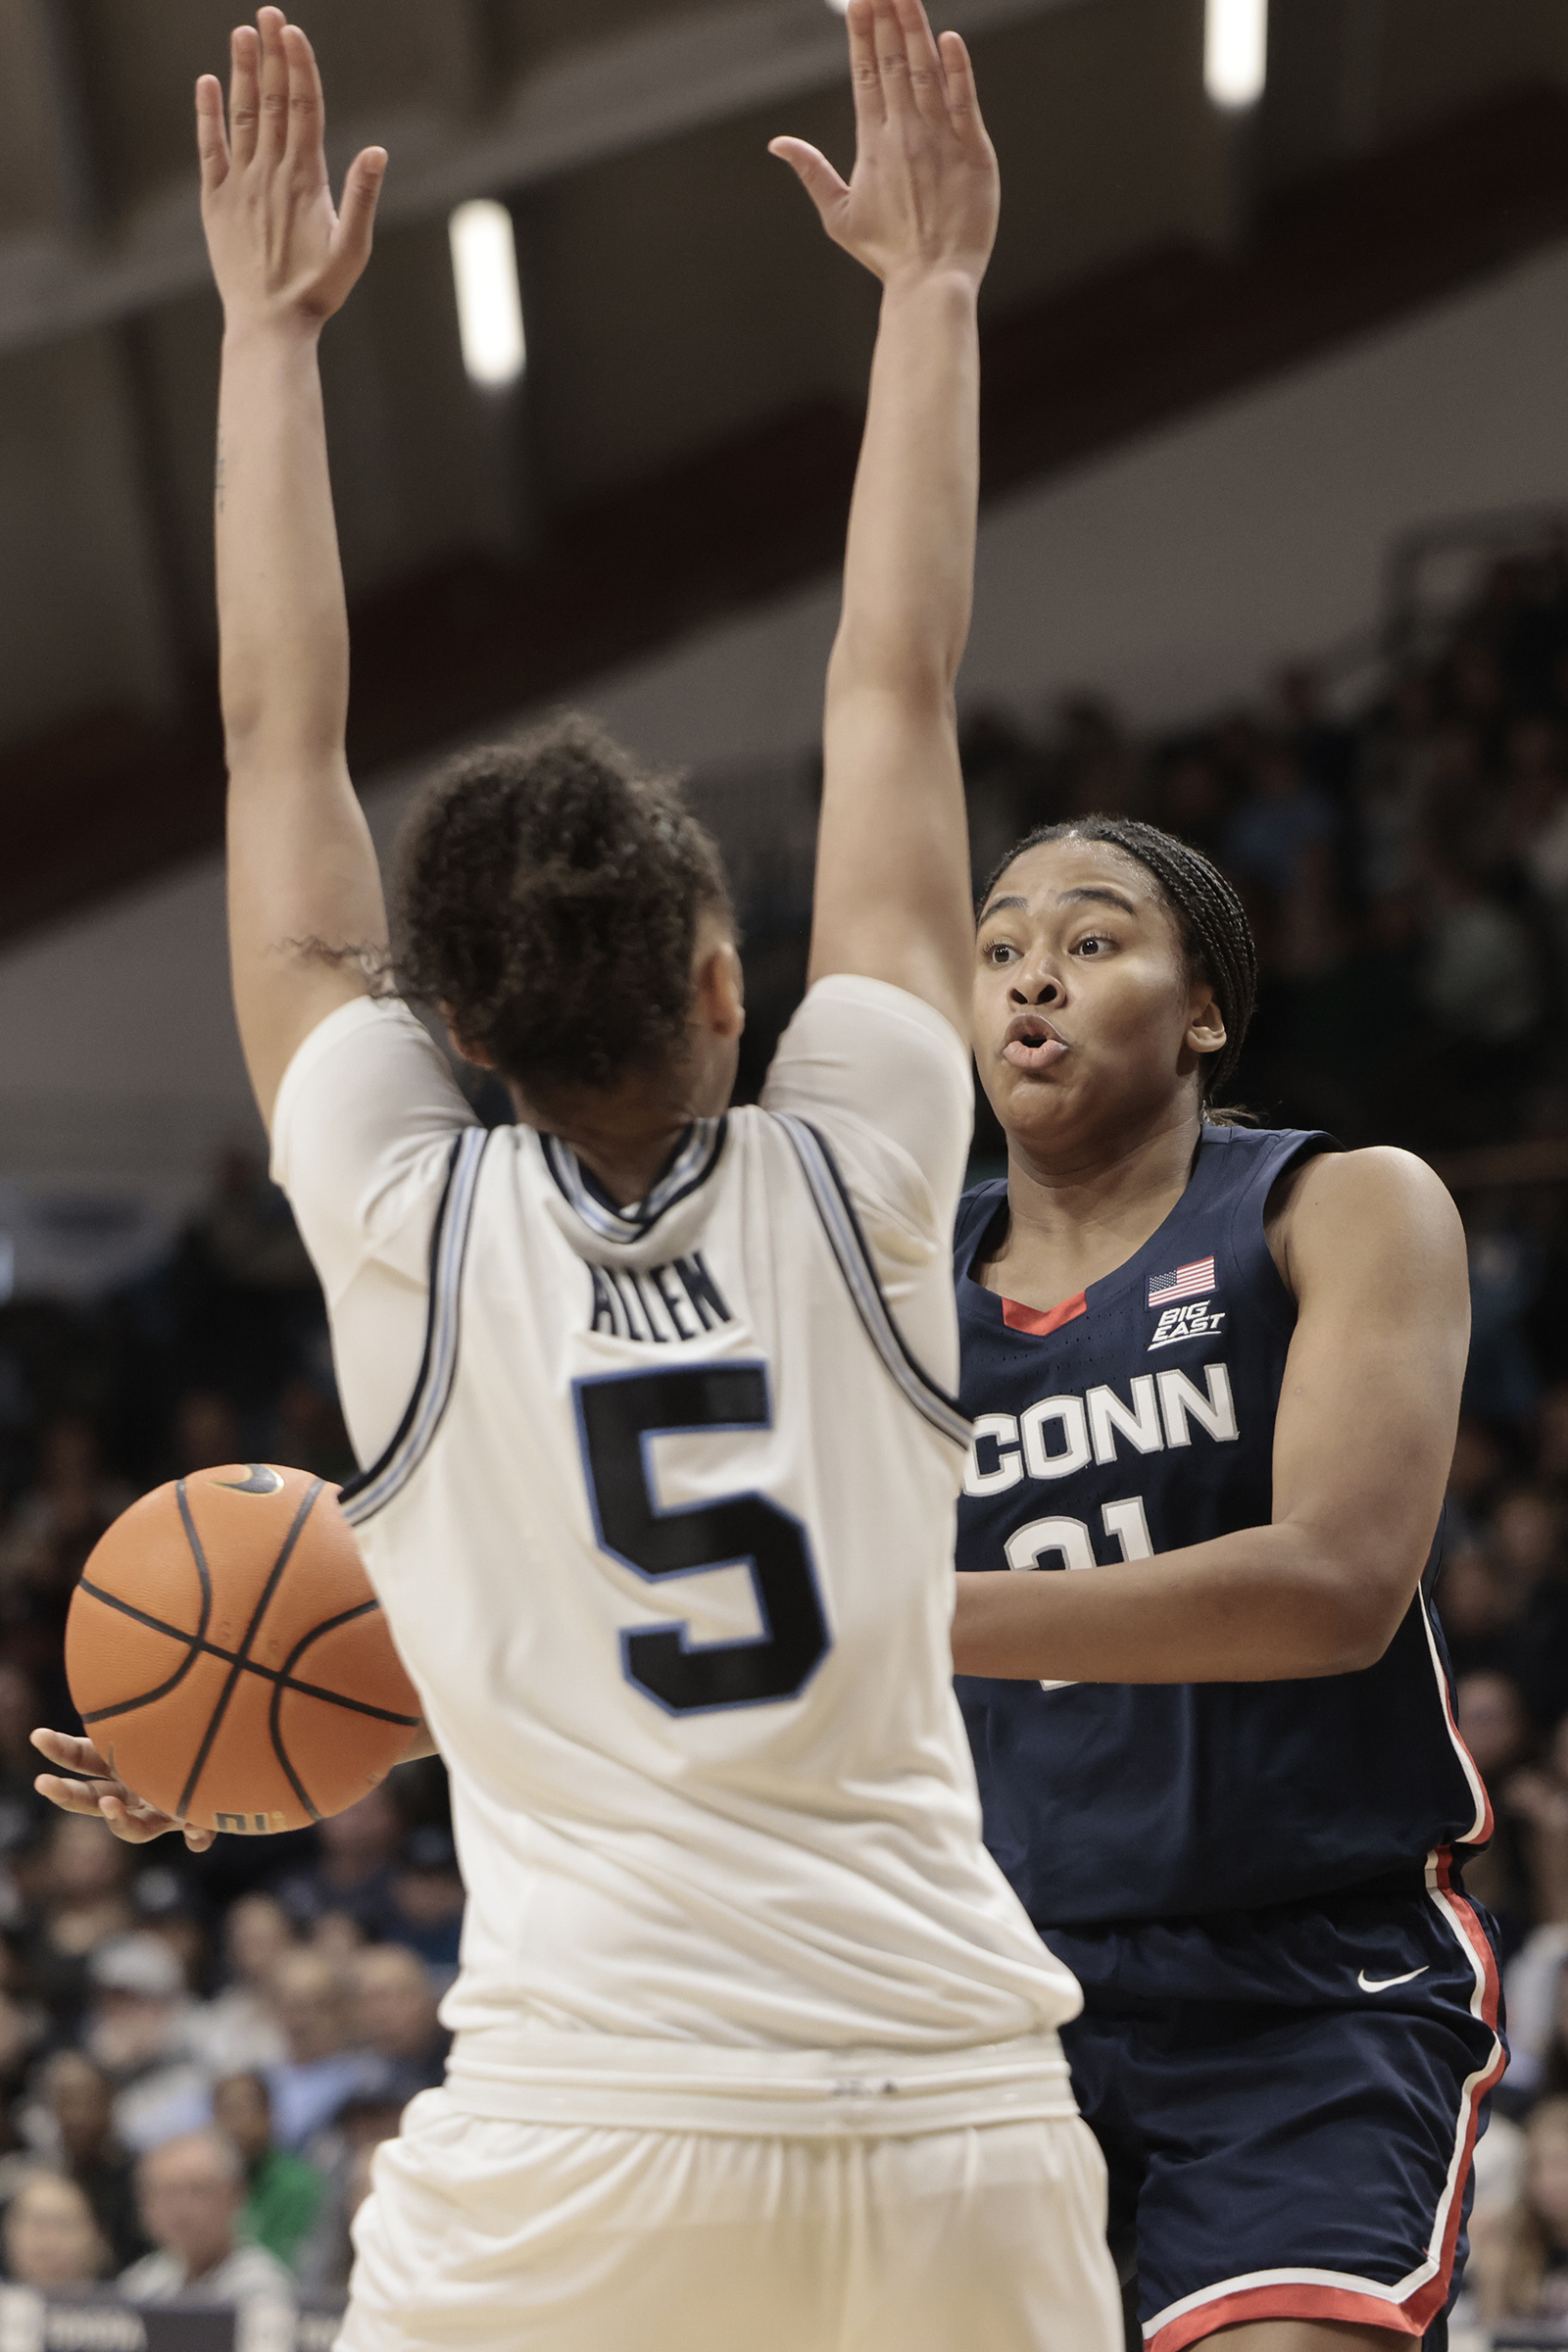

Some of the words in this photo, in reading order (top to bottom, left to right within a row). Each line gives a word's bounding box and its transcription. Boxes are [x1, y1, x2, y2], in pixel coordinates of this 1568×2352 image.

[589, 1250, 733, 1343] ALLEN
[1158, 1299, 1211, 1327] BIG
[1152, 1313, 1225, 1343] EAST
[570, 1358, 835, 1718] 5
